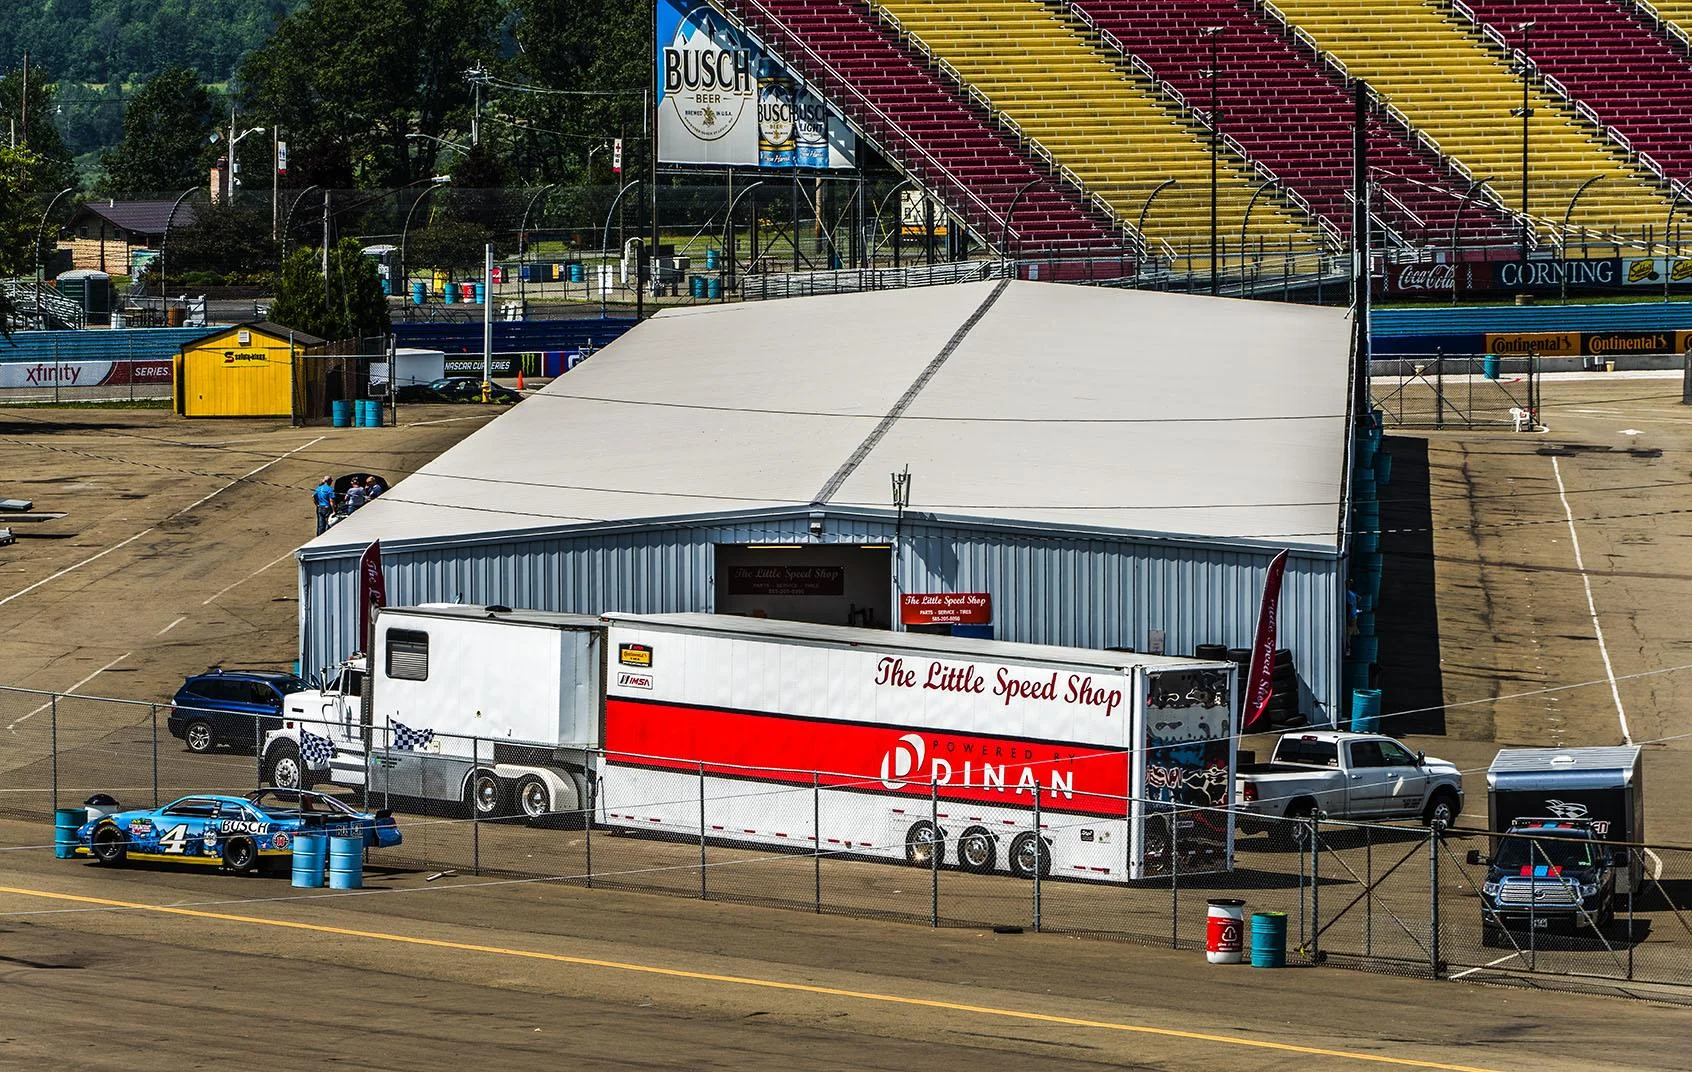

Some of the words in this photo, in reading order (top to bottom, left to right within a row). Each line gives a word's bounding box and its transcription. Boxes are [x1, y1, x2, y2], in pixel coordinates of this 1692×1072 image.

[664, 48, 753, 95] BUSCH
[696, 94, 721, 103] BEER
[758, 103, 794, 122] BUSCH
[801, 123, 823, 132] LIGHT
[1502, 261, 1613, 285] CORNING
[1492, 335, 1561, 354] Continental
[1588, 335, 1657, 354] Continental
[26, 363, 82, 385] xfinity
[134, 367, 169, 376] SERIES
[444, 362, 471, 370] NASCAR
[490, 361, 511, 370] ERIES
[755, 568, 781, 578] Little
[785, 568, 812, 580] Speed
[814, 568, 838, 580] Shop
[905, 596, 920, 605] The
[921, 596, 942, 605] Little
[944, 596, 965, 606] Speed
[967, 596, 986, 606] Shop
[875, 656, 916, 688] The
[923, 661, 985, 694] Little
[993, 667, 1057, 706] Speed
[1064, 674, 1122, 717] Shop
[933, 739, 1033, 759] POWERED
[1053, 751, 1075, 764] BY
[931, 757, 1074, 800] DINAN
[221, 820, 268, 834] BUSCH
[159, 823, 189, 854] 4
